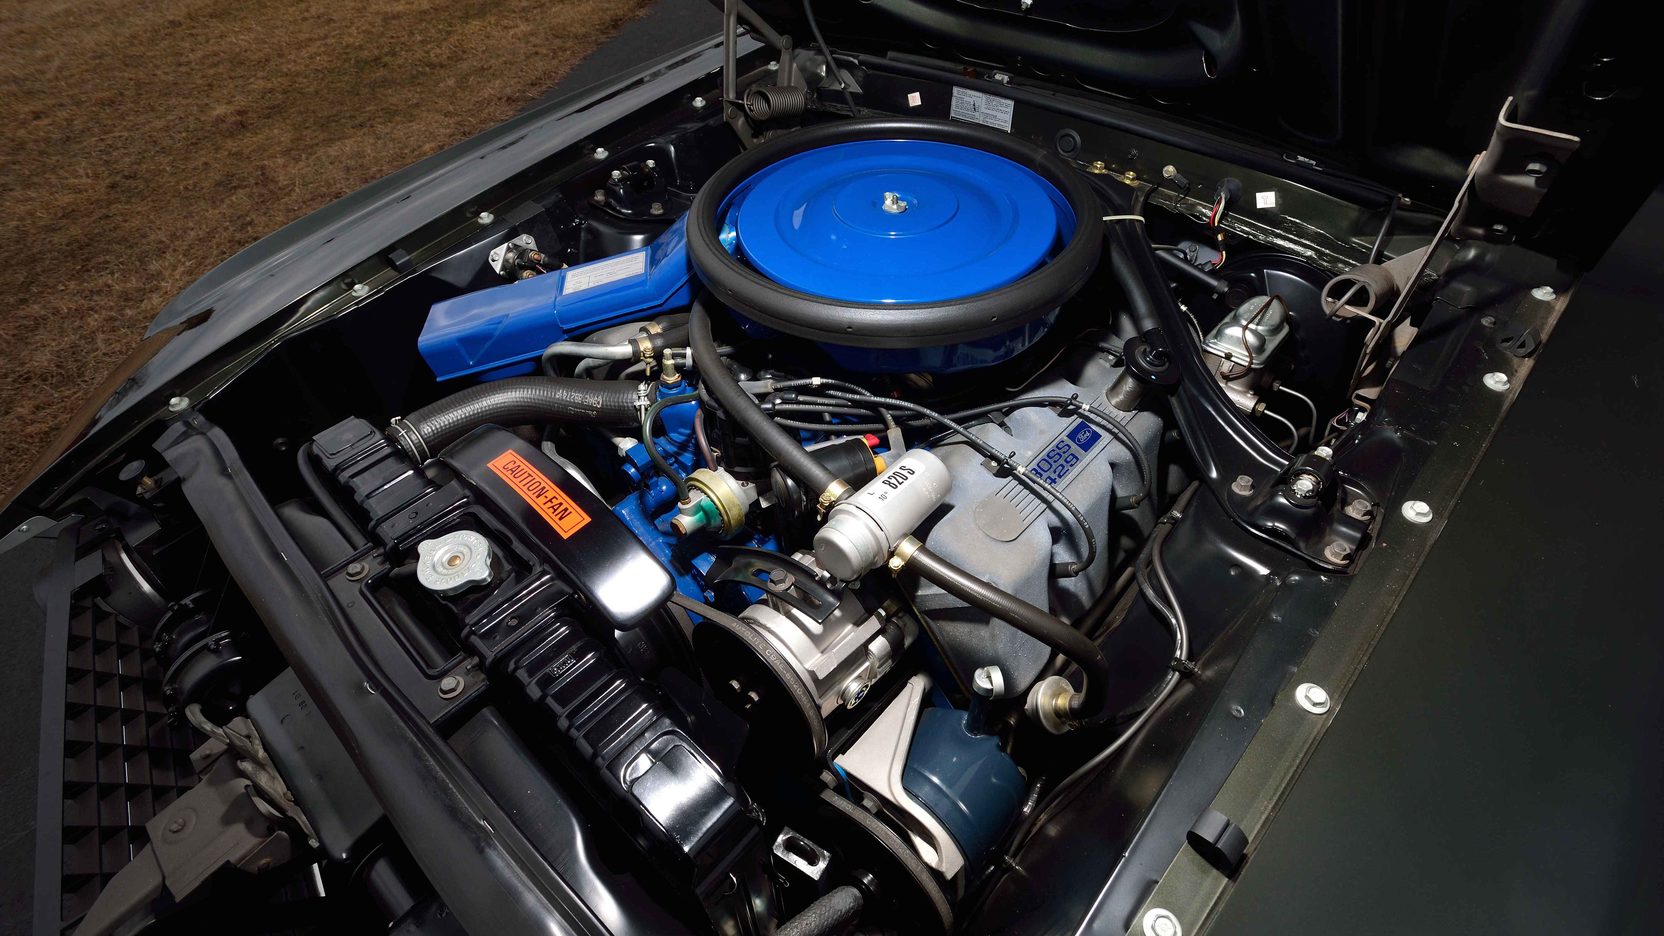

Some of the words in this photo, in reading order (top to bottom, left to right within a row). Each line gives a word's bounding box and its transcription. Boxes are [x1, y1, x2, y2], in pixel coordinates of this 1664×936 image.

[899, 465, 916, 476] S
[502, 460, 572, 521] CAUTION-FAN
[731, 622, 764, 650] AUTOLITE
